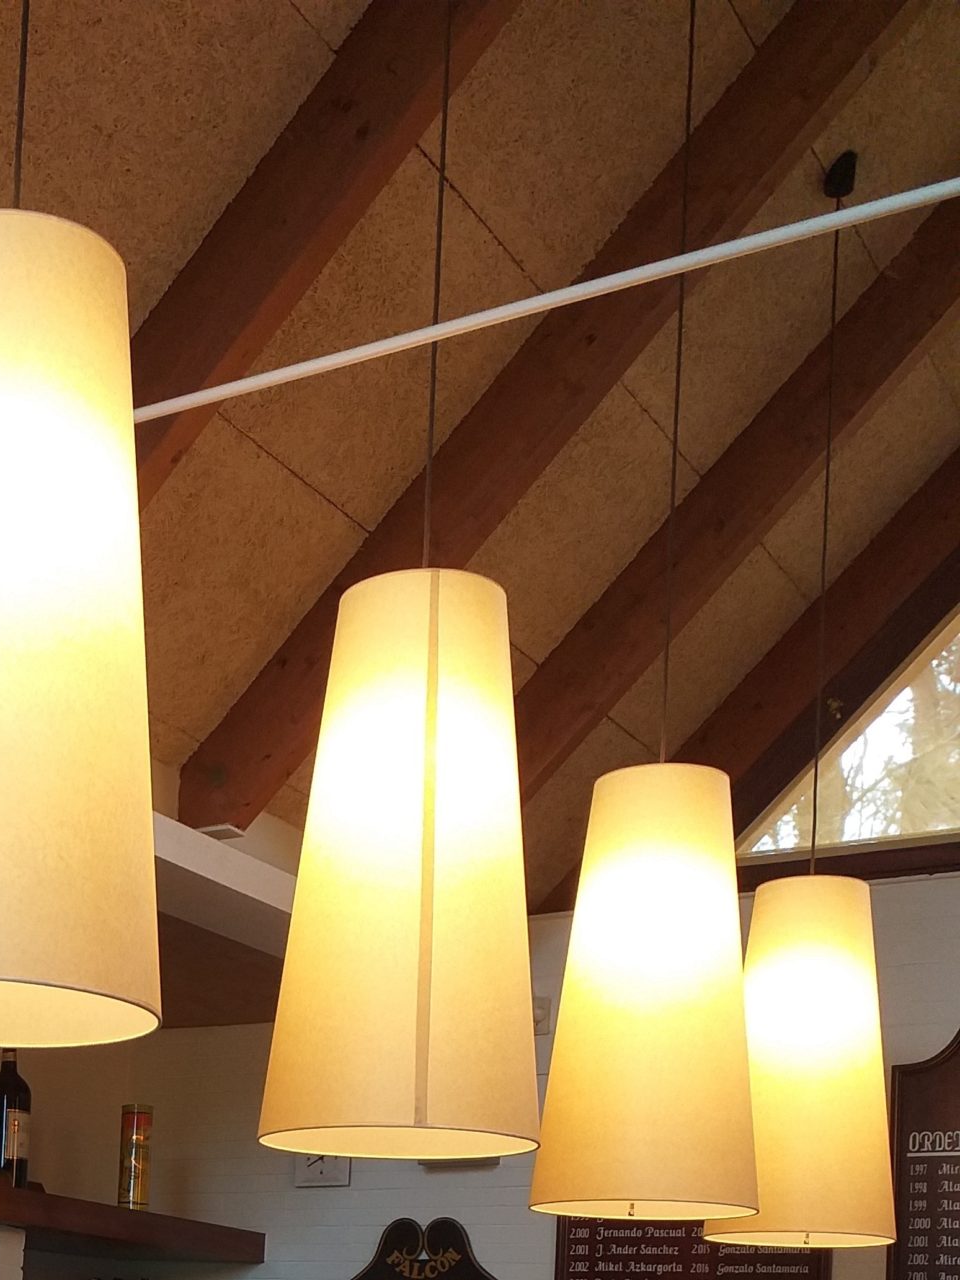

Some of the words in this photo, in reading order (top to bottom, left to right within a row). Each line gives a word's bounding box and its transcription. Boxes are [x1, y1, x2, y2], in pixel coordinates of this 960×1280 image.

[645, 1226, 686, 1237] Pascual
[607, 1244, 638, 1254] Ander
[386, 1248, 461, 1279] FALCON
[594, 1261, 622, 1272] Mikel
[626, 1261, 682, 1275] Azkargorta
[716, 1263, 754, 1276] Gonzalo
